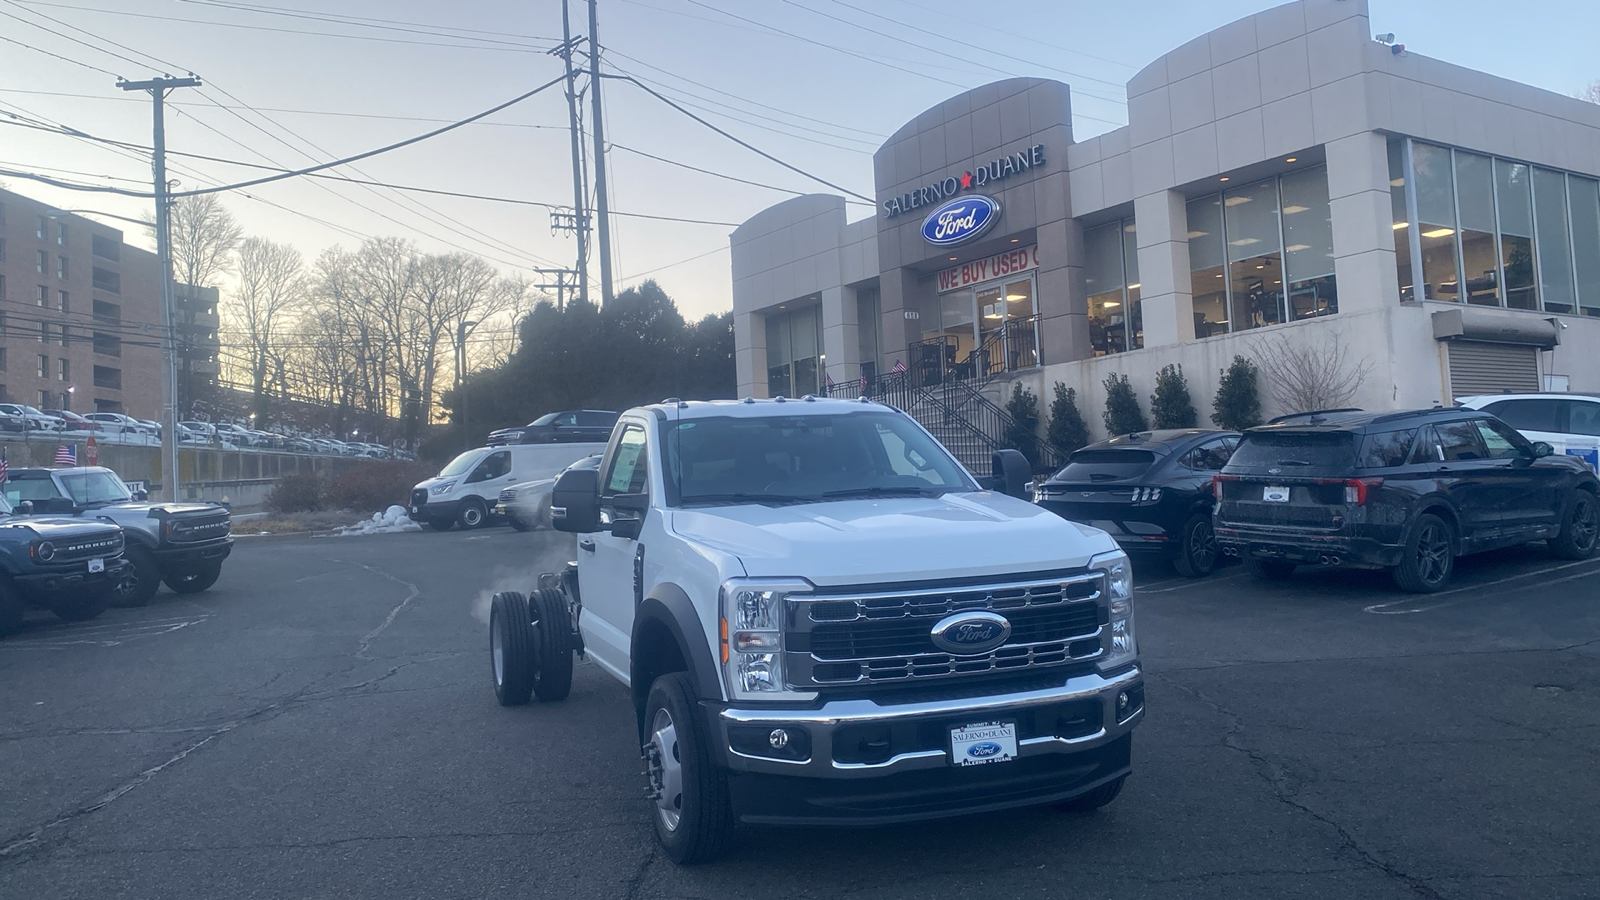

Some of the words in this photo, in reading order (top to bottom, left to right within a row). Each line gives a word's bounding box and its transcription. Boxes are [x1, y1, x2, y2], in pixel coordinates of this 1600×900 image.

[883, 176, 958, 219] SALERNO
[976, 144, 1046, 187] DUANE
[935, 206, 977, 239] Ford
[939, 268, 959, 290] WE
[962, 259, 987, 285] BUY
[992, 249, 1028, 277] USED
[126, 483, 140, 492] XIT
[194, 522, 224, 530] BRONCO
[68, 540, 113, 551] BRONCO
[956, 623, 992, 642] Ford
[953, 731, 985, 741] SALERNO
[988, 728, 1013, 738] DUANE
[974, 744, 995, 756] Ford
[961, 759, 987, 767] SALERNO
